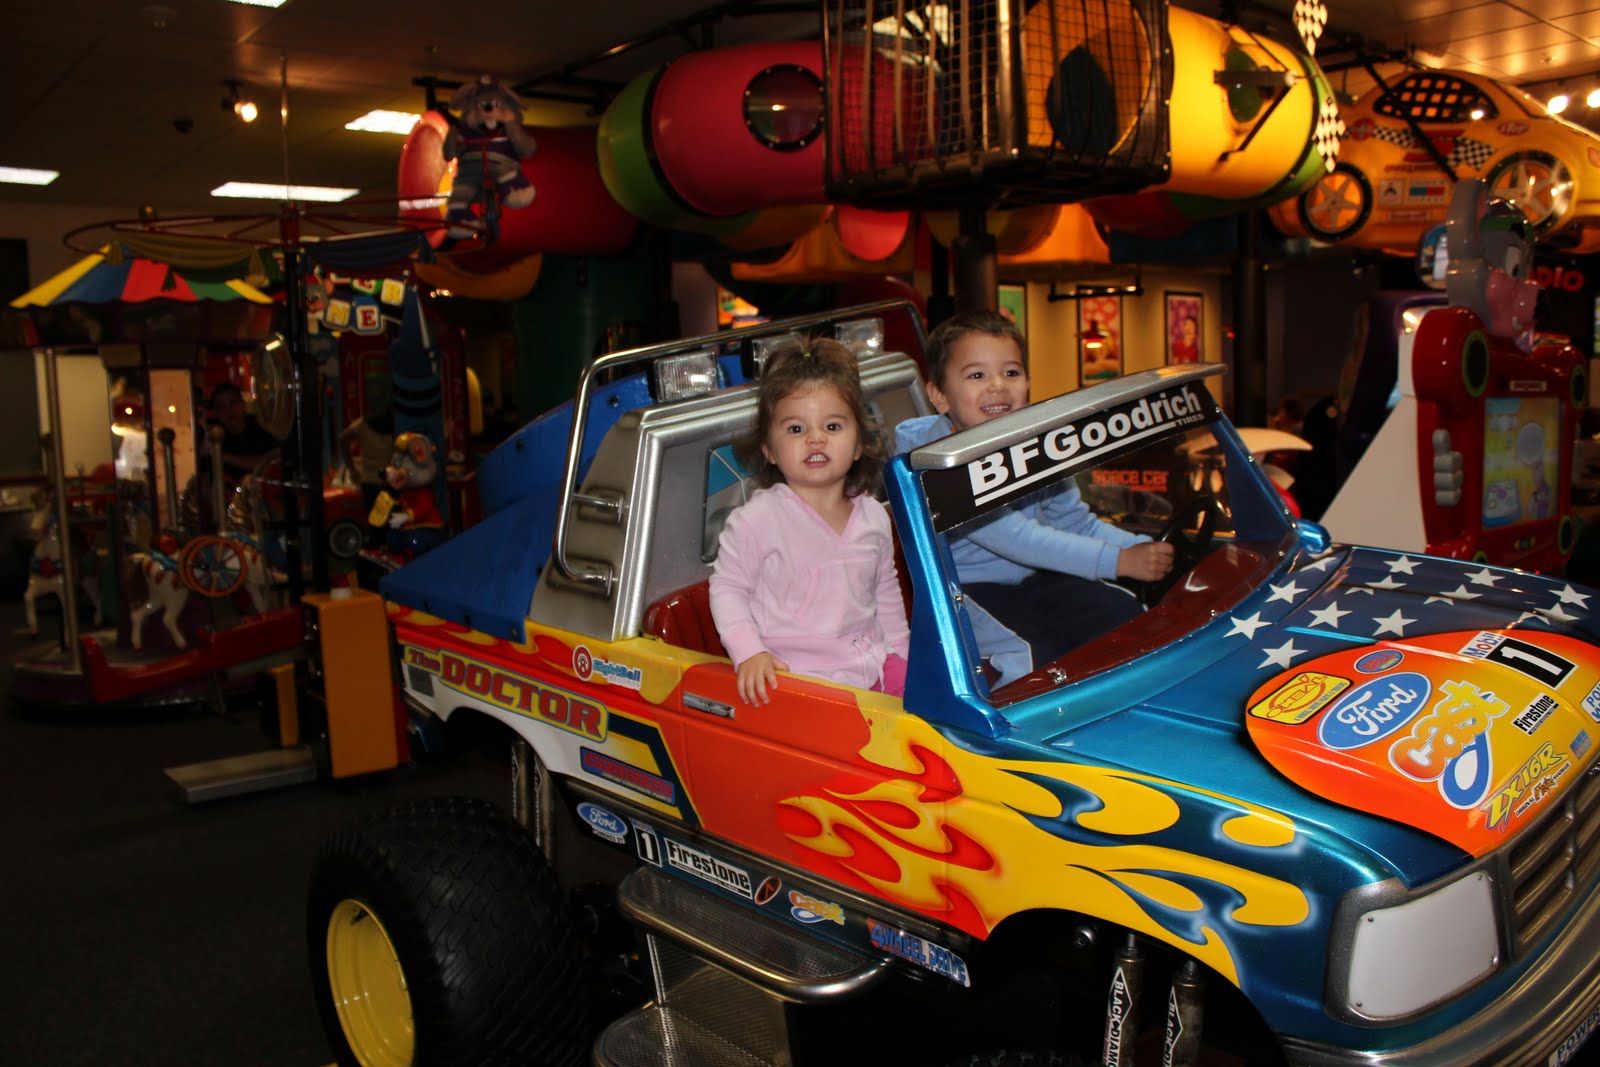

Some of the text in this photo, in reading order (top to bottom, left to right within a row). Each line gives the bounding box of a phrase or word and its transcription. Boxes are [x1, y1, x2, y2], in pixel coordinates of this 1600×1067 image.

[1175, 412, 1206, 427] TIRES
[967, 386, 1201, 496] BFGoodrich
[1500, 646, 1563, 676] 1
[409, 649, 603, 738] The DOCTOR
[1336, 683, 1418, 736] Ford
[1512, 694, 1555, 732] Firestone
[589, 806, 618, 832] Ford
[640, 832, 654, 861] 1
[667, 841, 750, 890] Firestone
[1112, 980, 1124, 1021] BLACK
